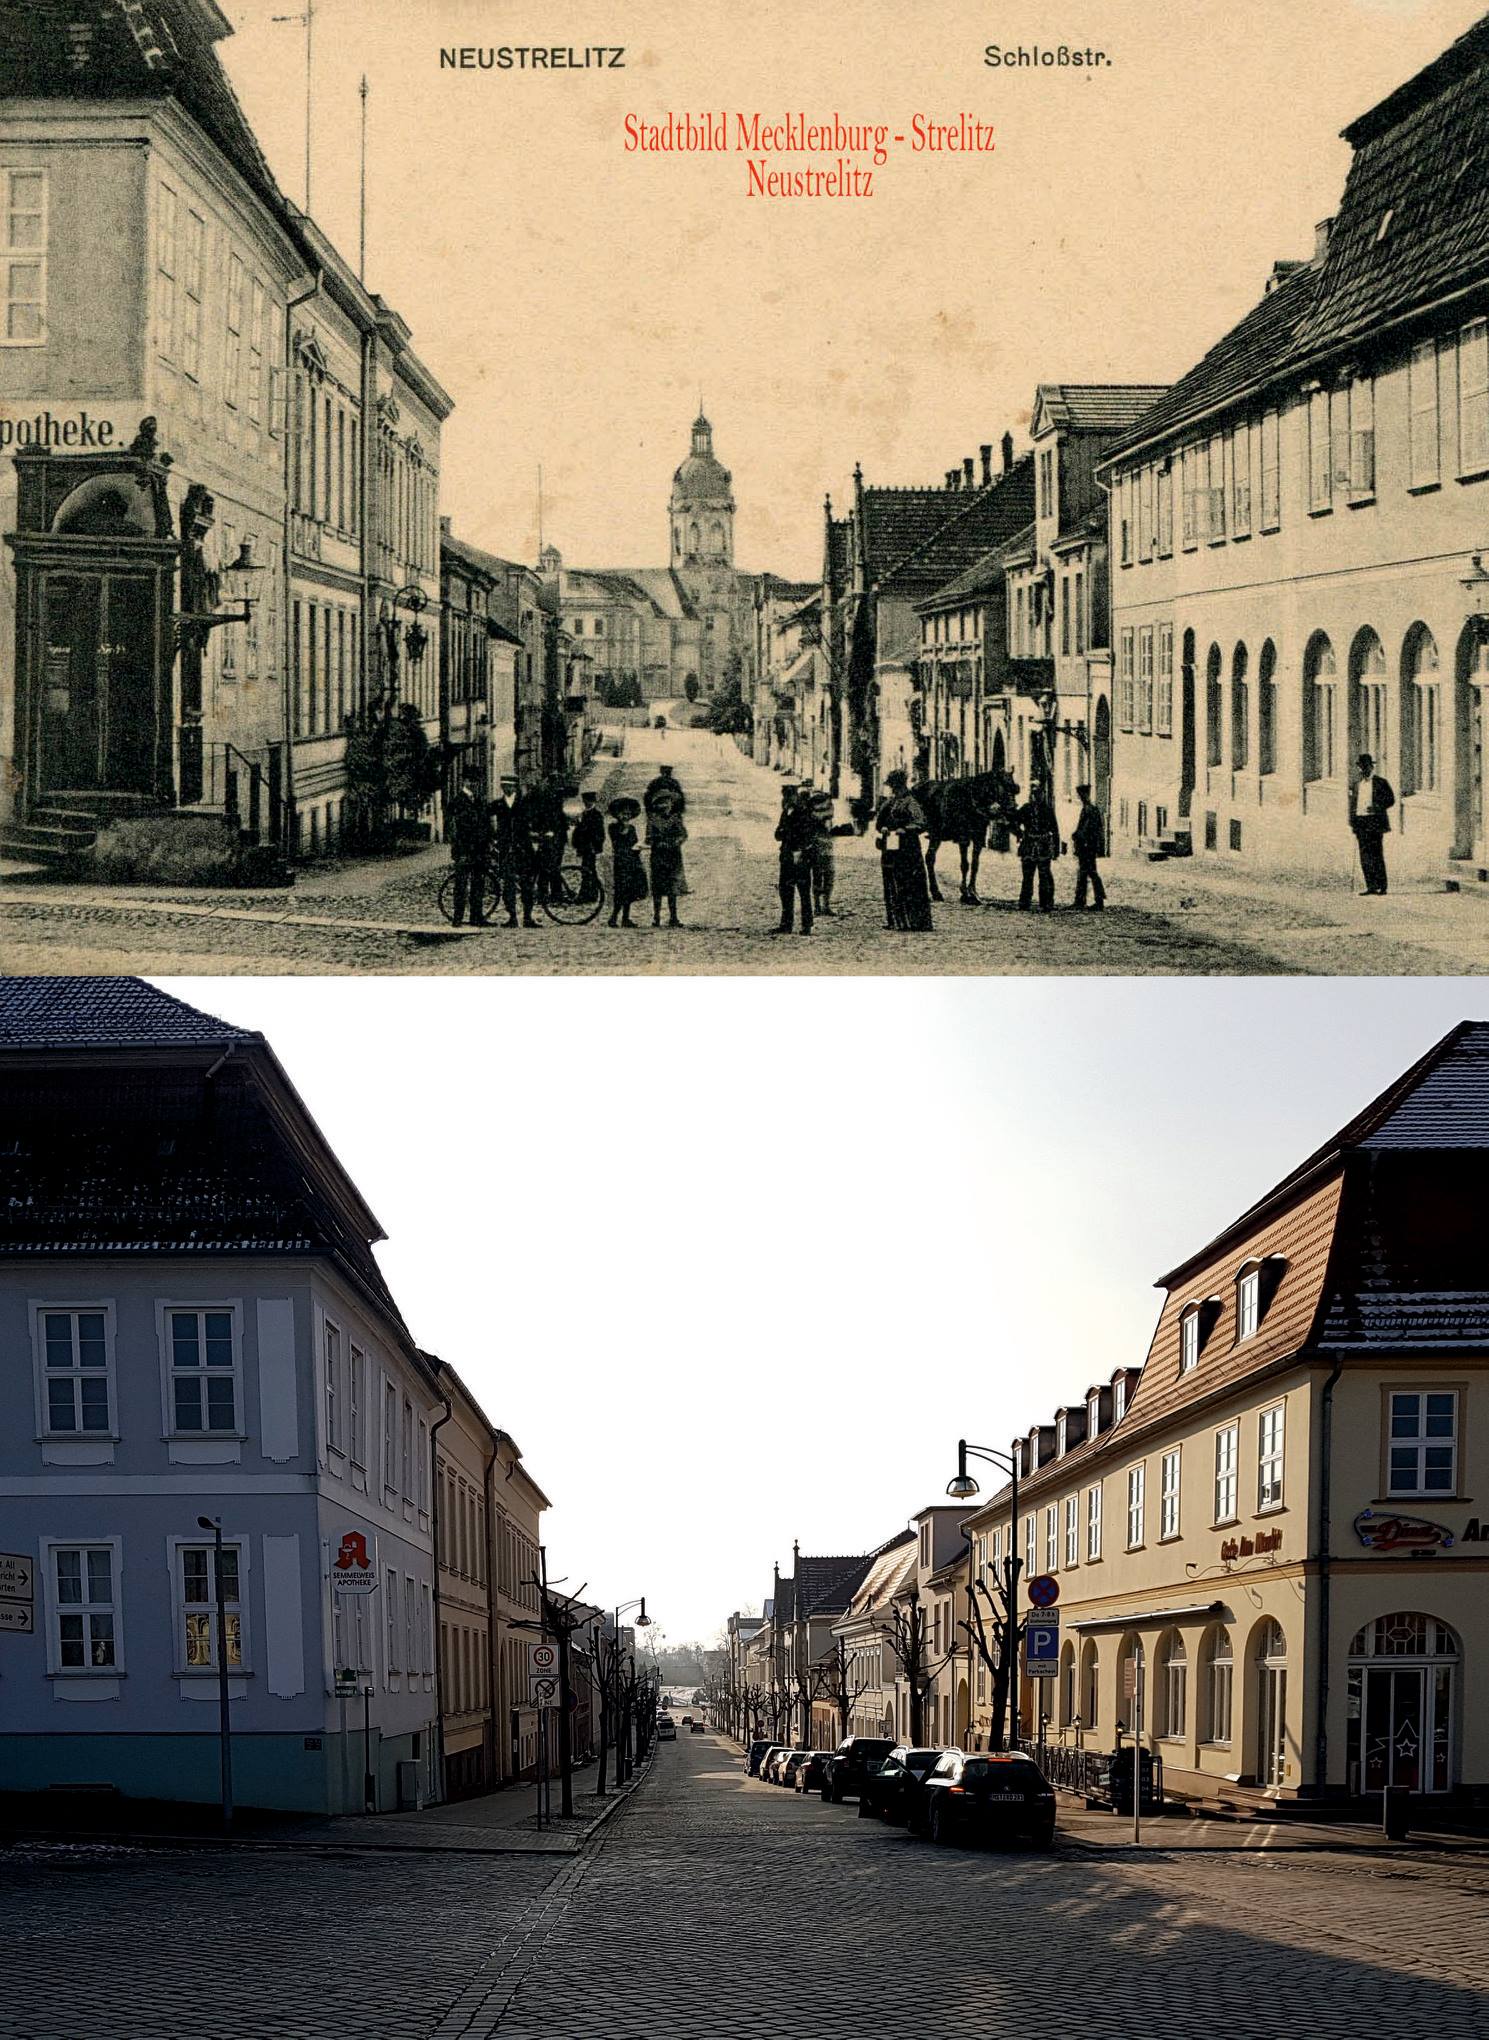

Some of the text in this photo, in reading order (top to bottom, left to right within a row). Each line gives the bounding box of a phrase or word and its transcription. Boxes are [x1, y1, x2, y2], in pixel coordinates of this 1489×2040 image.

[333, 1571, 375, 1579] SEMMELWEIS
[1034, 1631, 1051, 1655] P
[538, 1651, 550, 1661] 30
